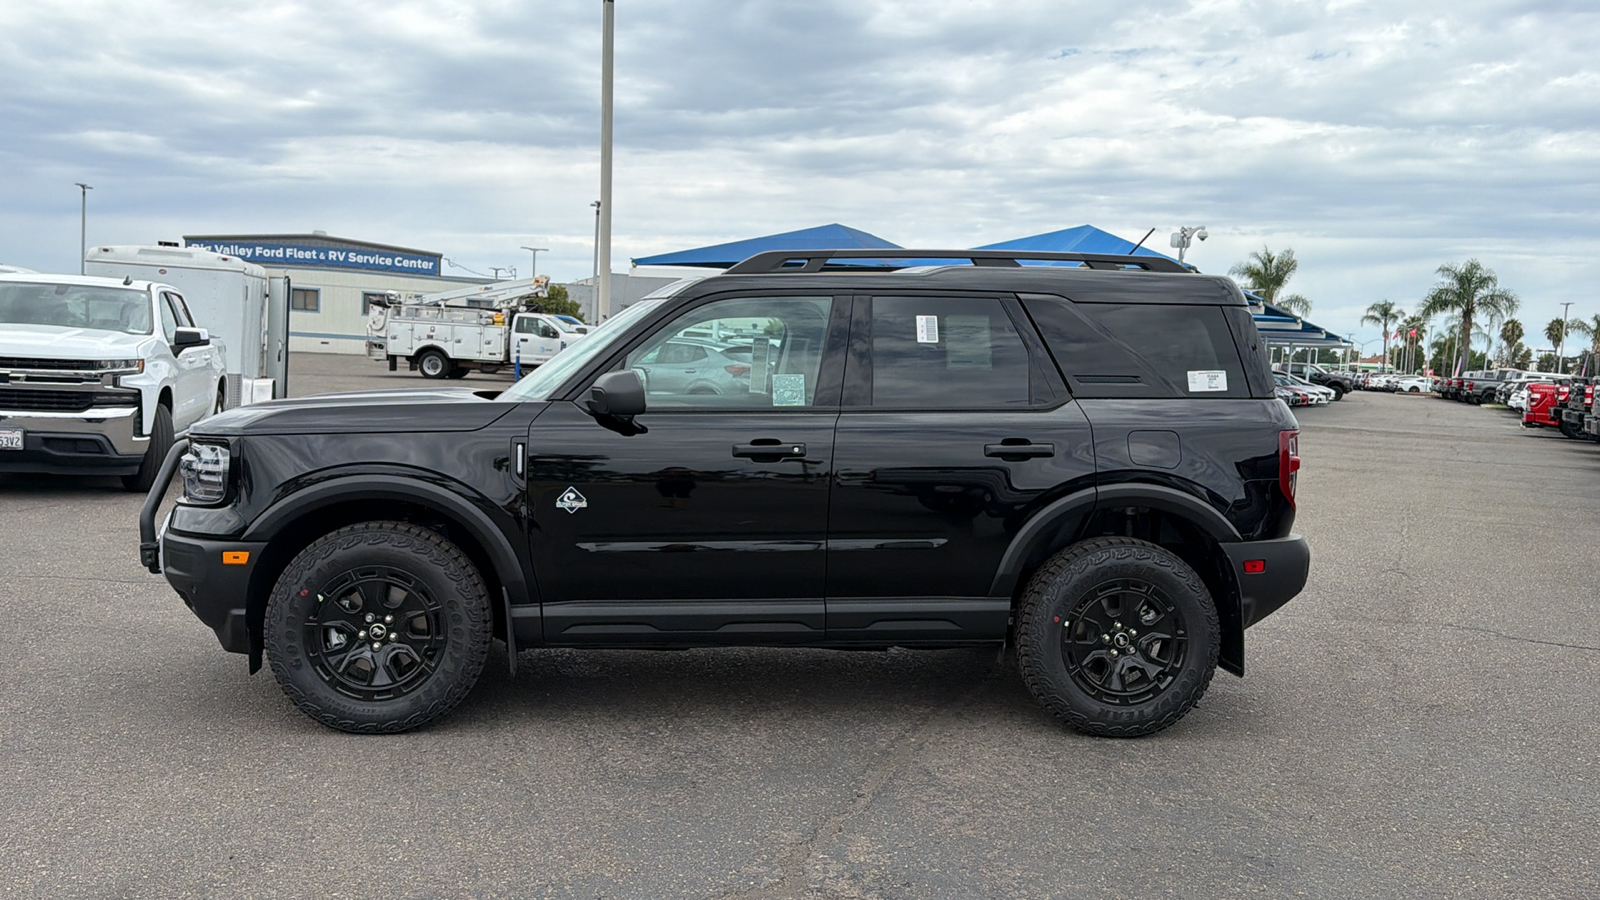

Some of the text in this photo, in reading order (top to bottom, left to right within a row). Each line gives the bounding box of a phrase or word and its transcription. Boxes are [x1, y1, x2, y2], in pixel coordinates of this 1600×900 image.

[214, 244, 253, 258] Valley
[255, 246, 283, 257] Ford
[286, 248, 317, 259] Fleet
[319, 252, 326, 260] &
[328, 250, 346, 261] RV
[348, 252, 393, 266] Service
[394, 257, 434, 270] Center
